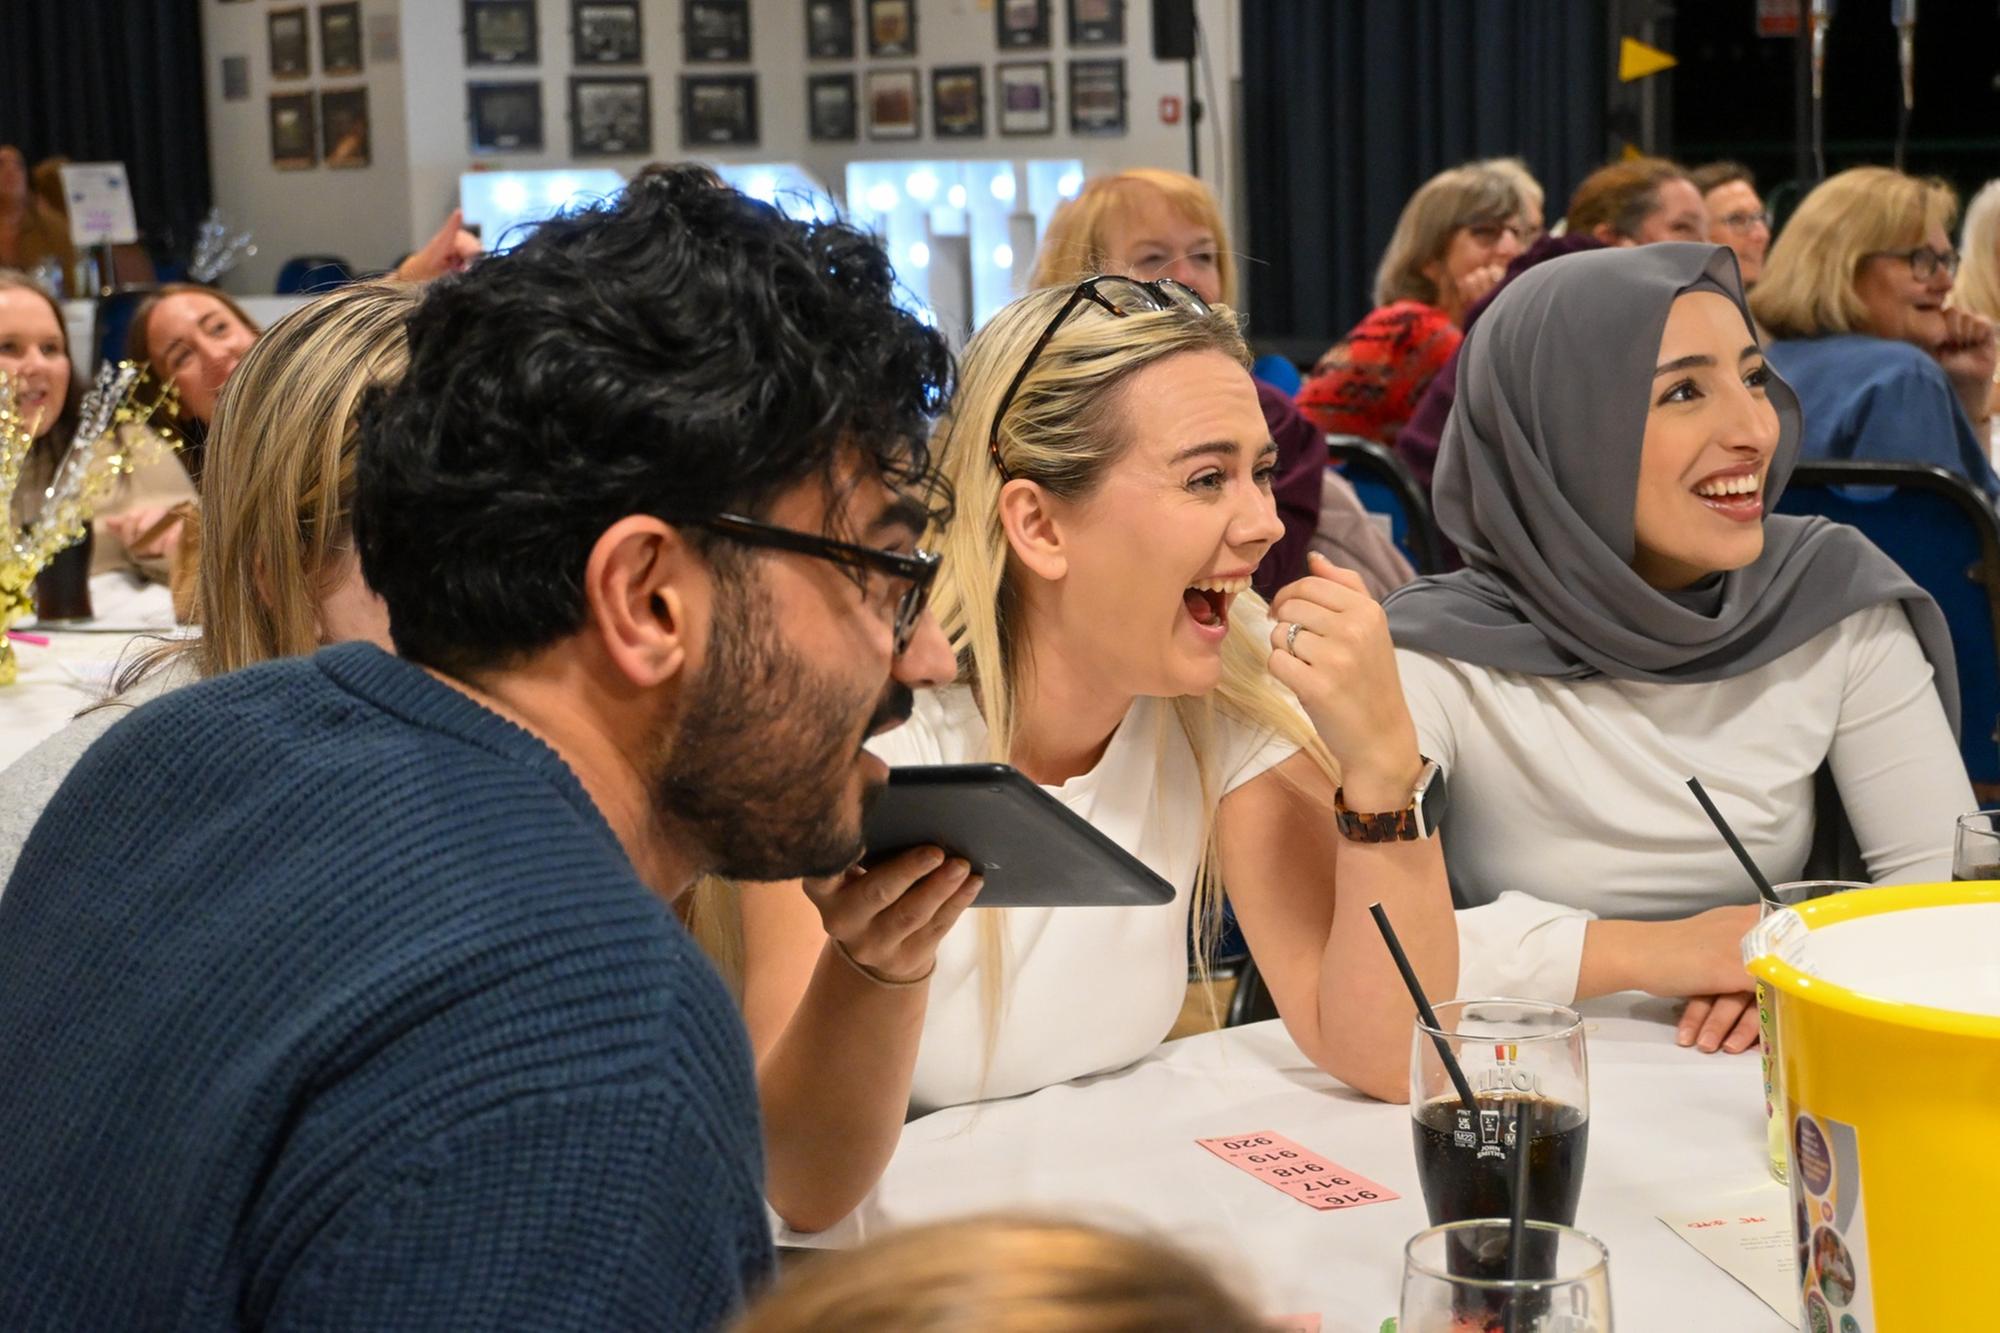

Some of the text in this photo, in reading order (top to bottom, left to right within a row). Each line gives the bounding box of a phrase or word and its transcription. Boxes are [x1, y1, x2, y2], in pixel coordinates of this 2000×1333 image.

[1223, 1136, 1273, 1150] 920
[1248, 1150, 1299, 1164] 919
[1273, 1163, 1325, 1178] 918
[1303, 1177, 1351, 1192] 917
[1325, 1190, 1379, 1205] 916
